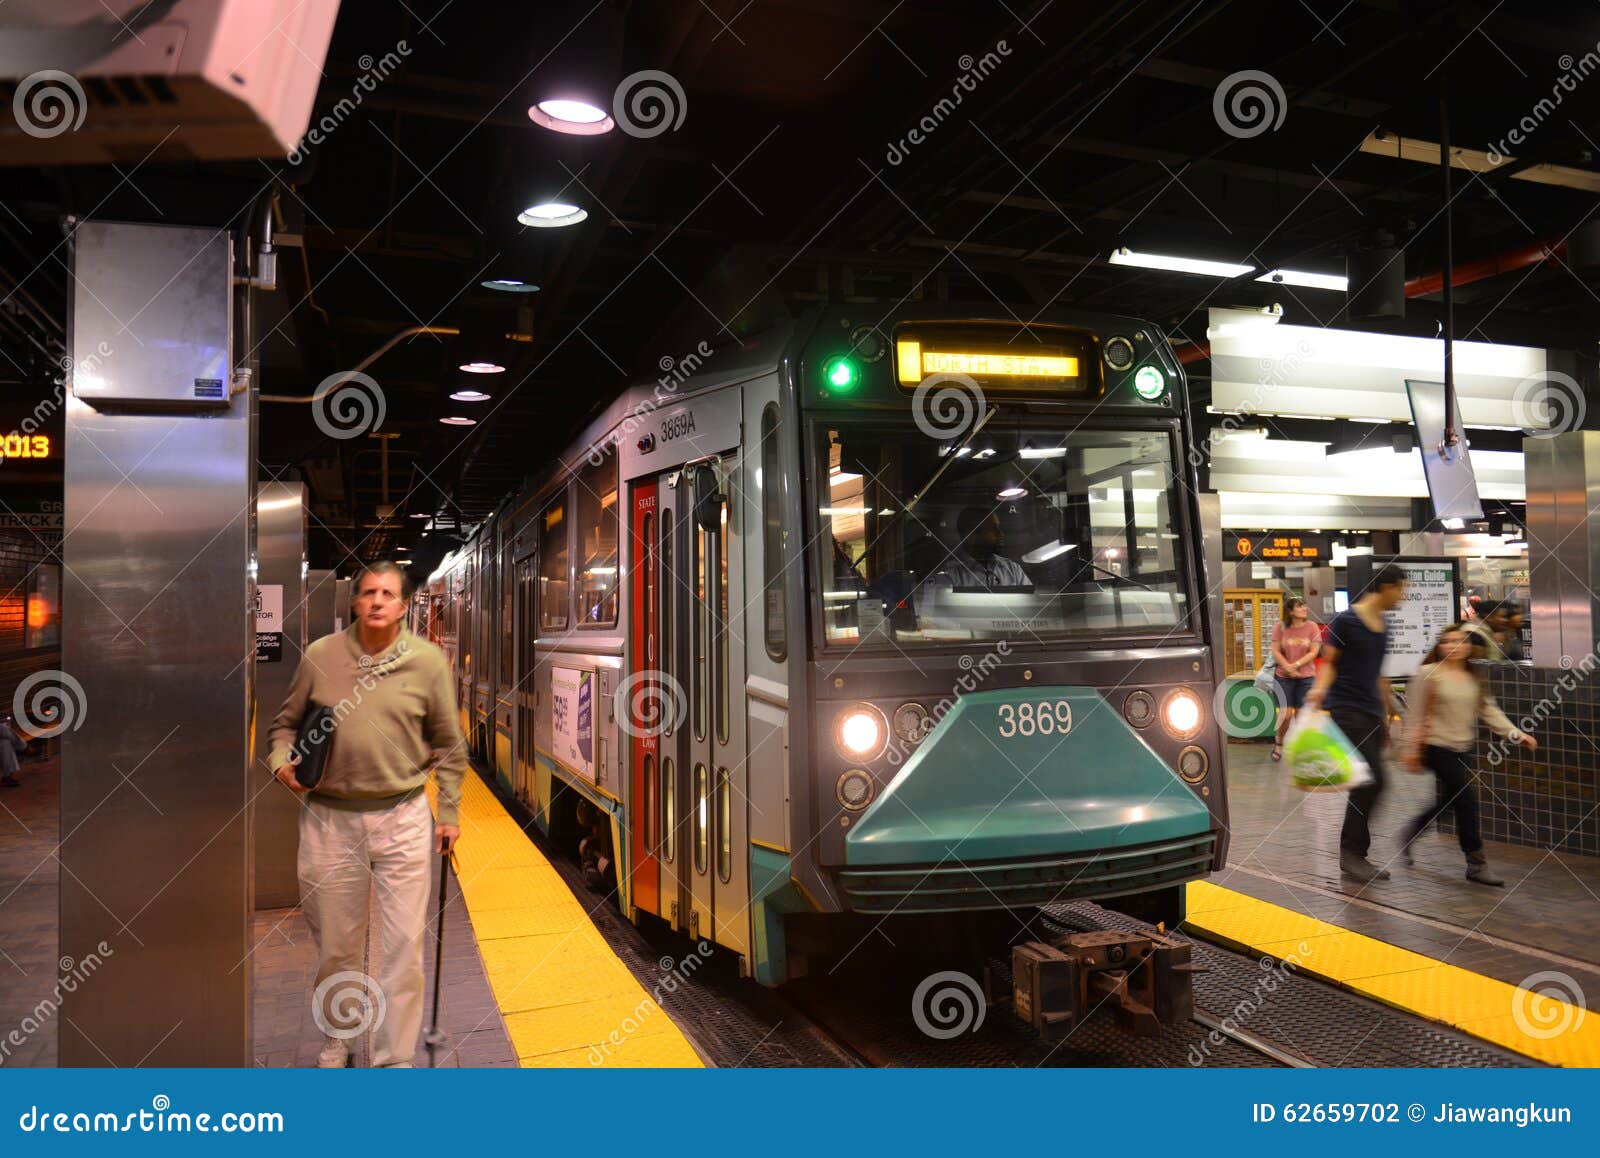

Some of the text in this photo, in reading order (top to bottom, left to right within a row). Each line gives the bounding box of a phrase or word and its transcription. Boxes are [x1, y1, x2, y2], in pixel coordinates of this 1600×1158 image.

[925, 355, 989, 372] NORTH
[660, 411, 696, 442] 3869A
[638, 495, 656, 510] STATE
[0, 515, 49, 528] TRACK
[1424, 570, 1446, 582] Guide
[998, 700, 1073, 738] 3869
[642, 736, 656, 750] LAW
